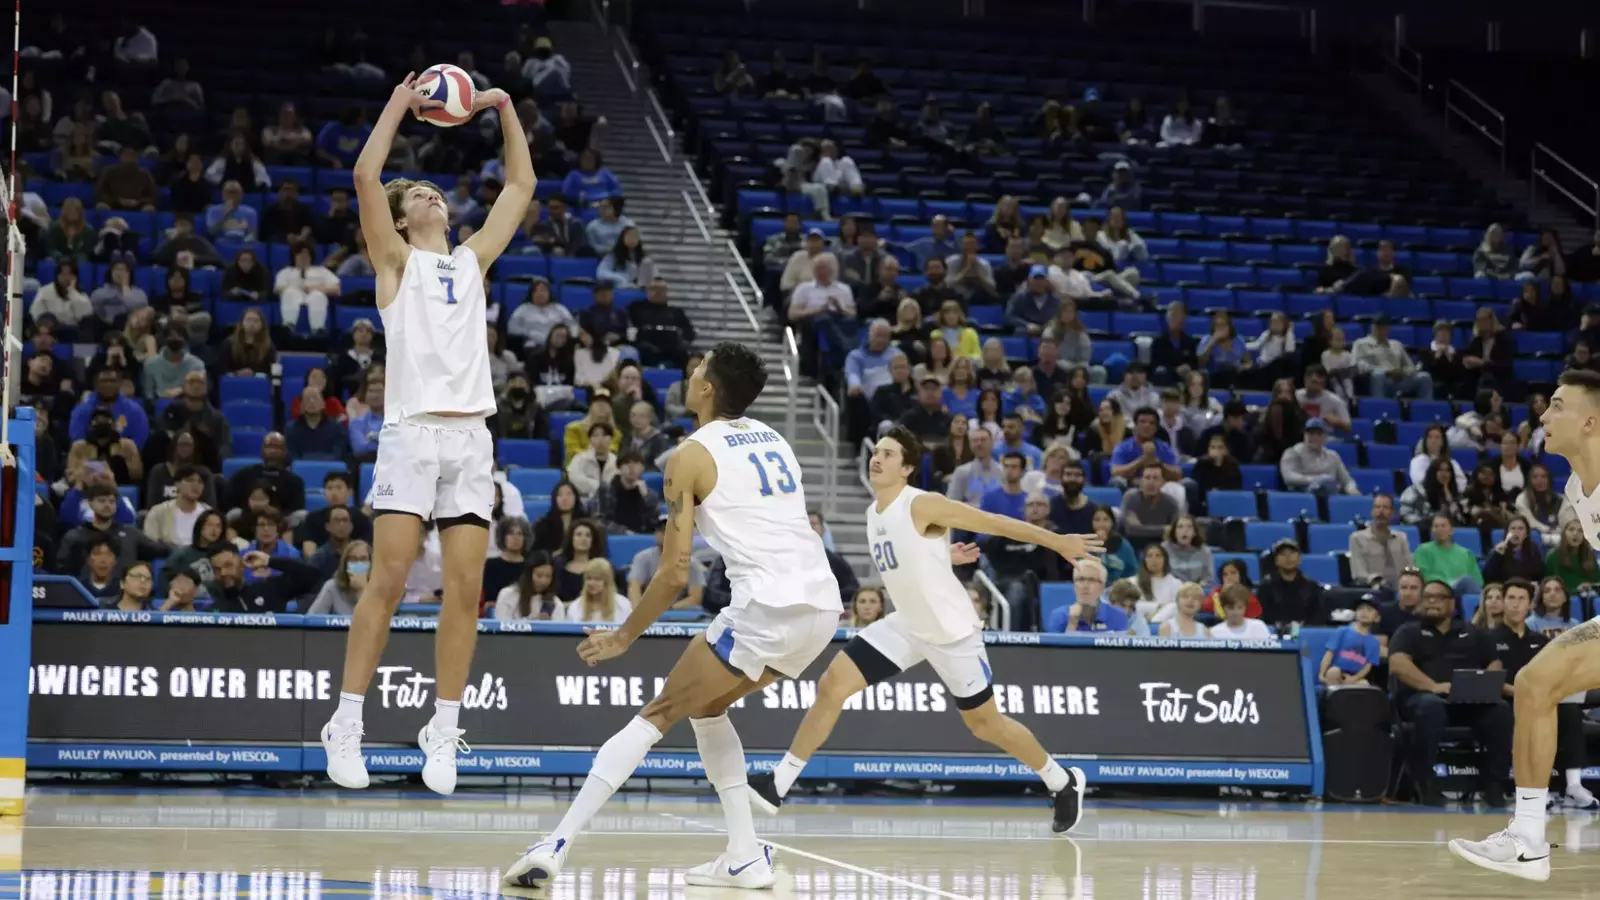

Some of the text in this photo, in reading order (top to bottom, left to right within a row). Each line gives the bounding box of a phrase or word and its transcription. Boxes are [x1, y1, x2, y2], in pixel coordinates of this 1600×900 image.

[438, 276, 457, 304] 7
[723, 431, 780, 447] BRUINS
[748, 451, 797, 496] 13
[874, 541, 899, 572] 20
[62, 611, 104, 622] PAULEY
[169, 667, 246, 698] OVER
[257, 669, 331, 700] HERE
[377, 666, 436, 708] Fat
[461, 672, 508, 710] al's
[555, 675, 645, 706] WE'RE
[1033, 684, 1099, 715] HERE
[1139, 682, 1260, 724] Fat Sal's
[58, 749, 101, 760] PAULEY
[103, 750, 157, 761] PAVILION
[160, 751, 214, 763] presented
[215, 751, 231, 764] by
[371, 755, 423, 765] PAVILION
[479, 756, 493, 770] by
[494, 756, 540, 768] WESCOM
[854, 762, 891, 773] PAULEY
[894, 762, 943, 774] PAVILION
[944, 764, 993, 776] presented
[994, 764, 1008, 776] by
[1099, 765, 1290, 780] PAULEY PAVILION presented by WESCOM
